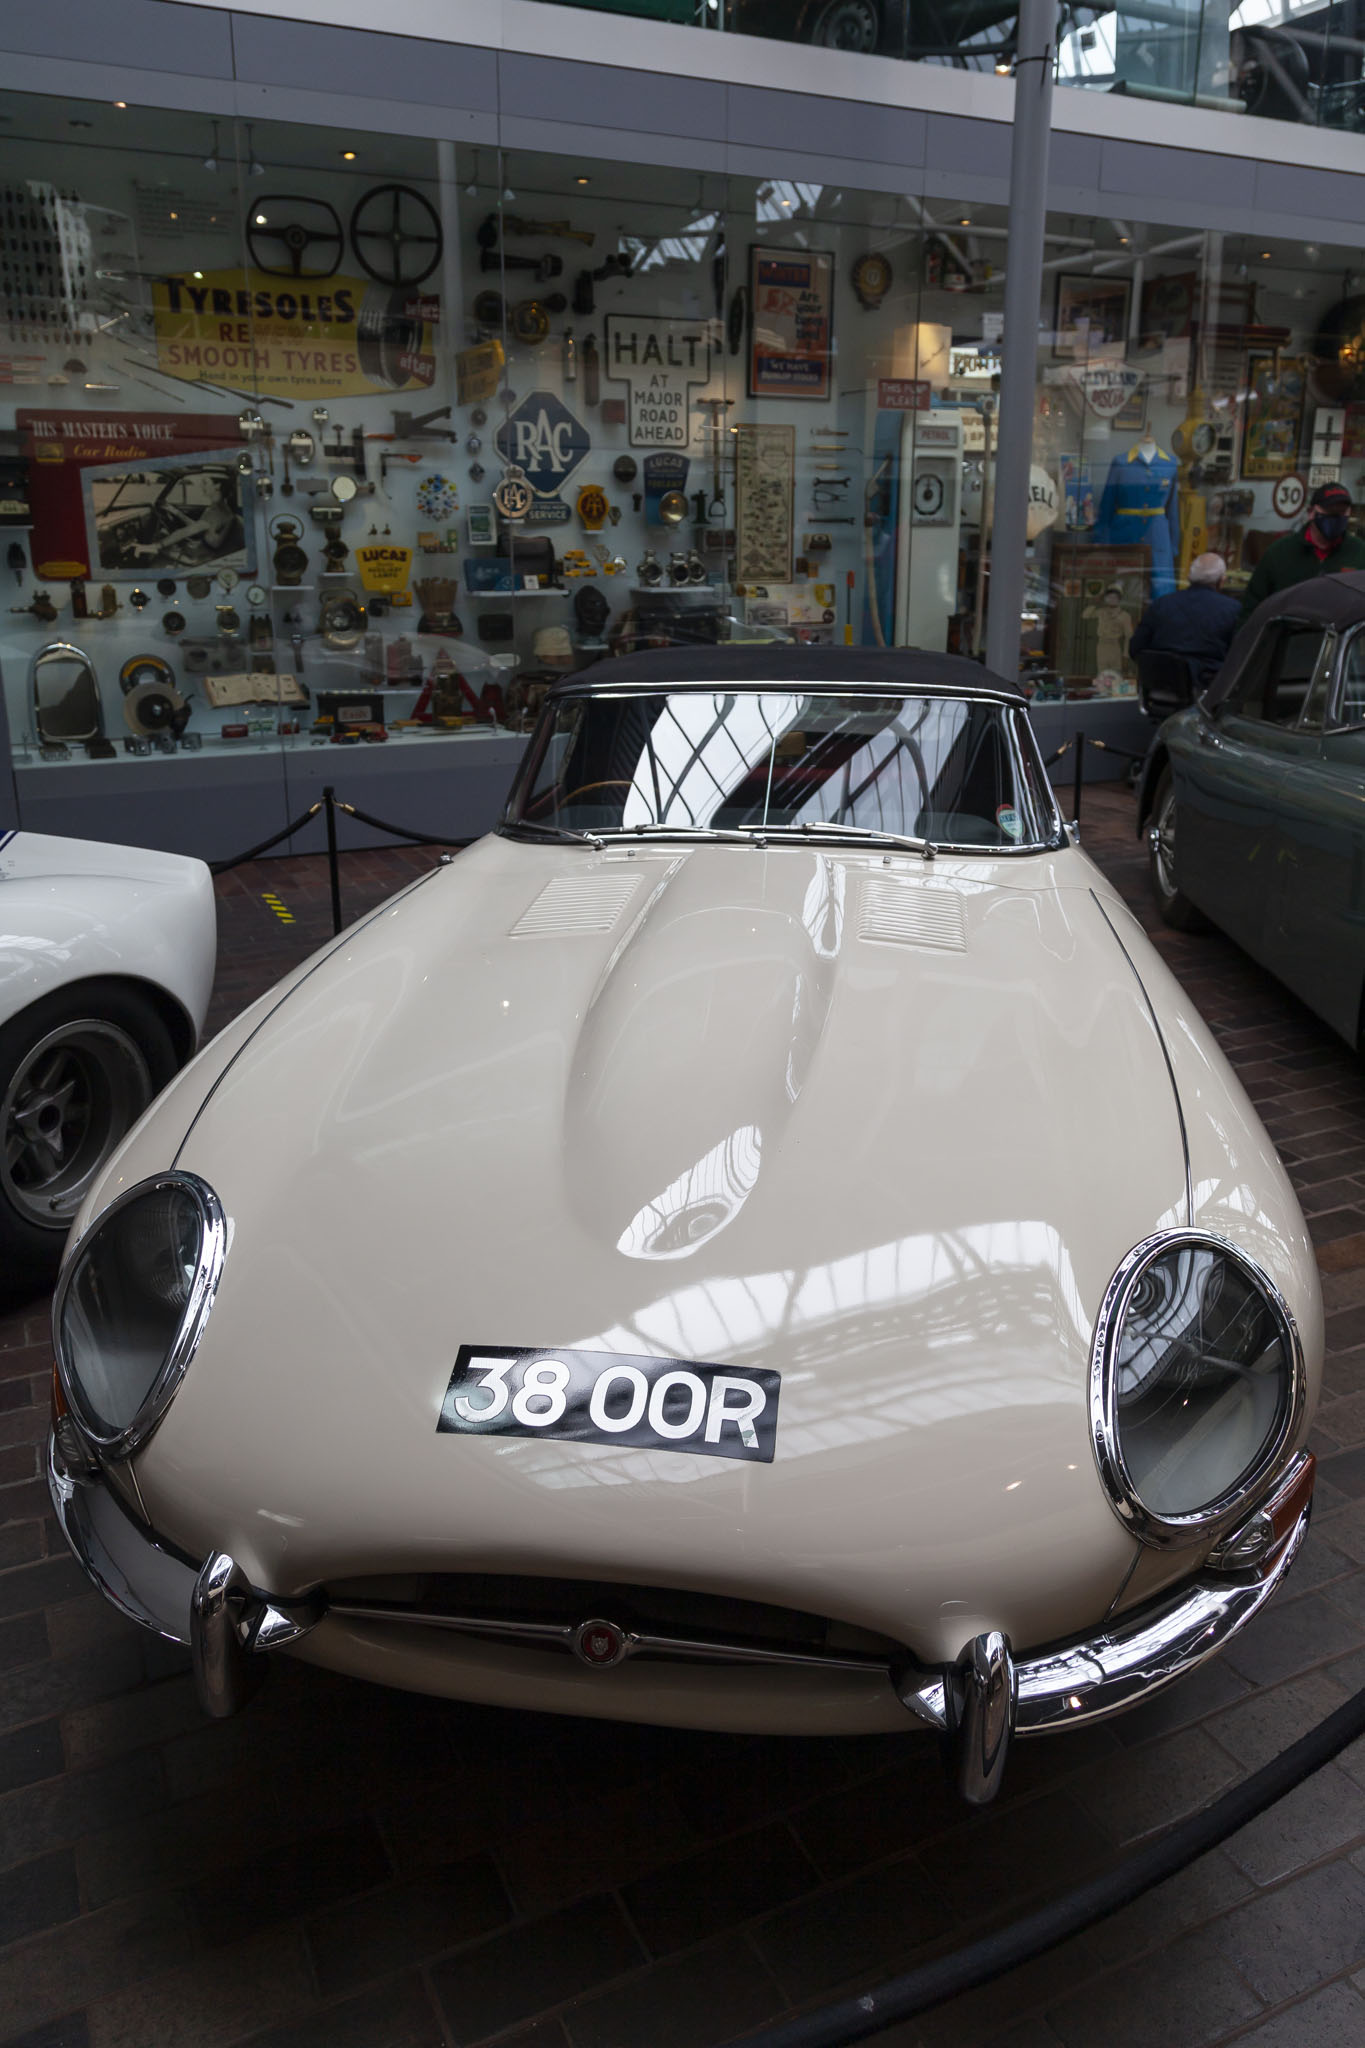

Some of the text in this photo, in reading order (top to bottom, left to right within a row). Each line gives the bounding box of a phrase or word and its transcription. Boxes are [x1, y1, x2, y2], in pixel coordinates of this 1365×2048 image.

[168, 277, 356, 324] TYRESOLES
[614, 331, 702, 367] HALT
[168, 344, 357, 373] SMOOTH TYRES
[400, 354, 434, 380] after
[290, 375, 317, 386] tyres
[650, 374, 669, 388] AT
[880, 382, 900, 393] THIS
[634, 391, 684, 407] MAJOR
[639, 408, 679, 423] ROAD
[61, 421, 129, 440] MASTER'S
[634, 425, 684, 441] AHEAD
[921, 430, 951, 441] PETROL
[514, 408, 574, 473] RAC
[73, 444, 148, 458] Car Radio
[650, 455, 685, 469] LUCAS
[1028, 485, 1054, 509] ELL
[1279, 486, 1301, 505] 30
[529, 510, 567, 520] SERVICE
[362, 549, 408, 562] LUCAS
[453, 1356, 571, 1427] 38
